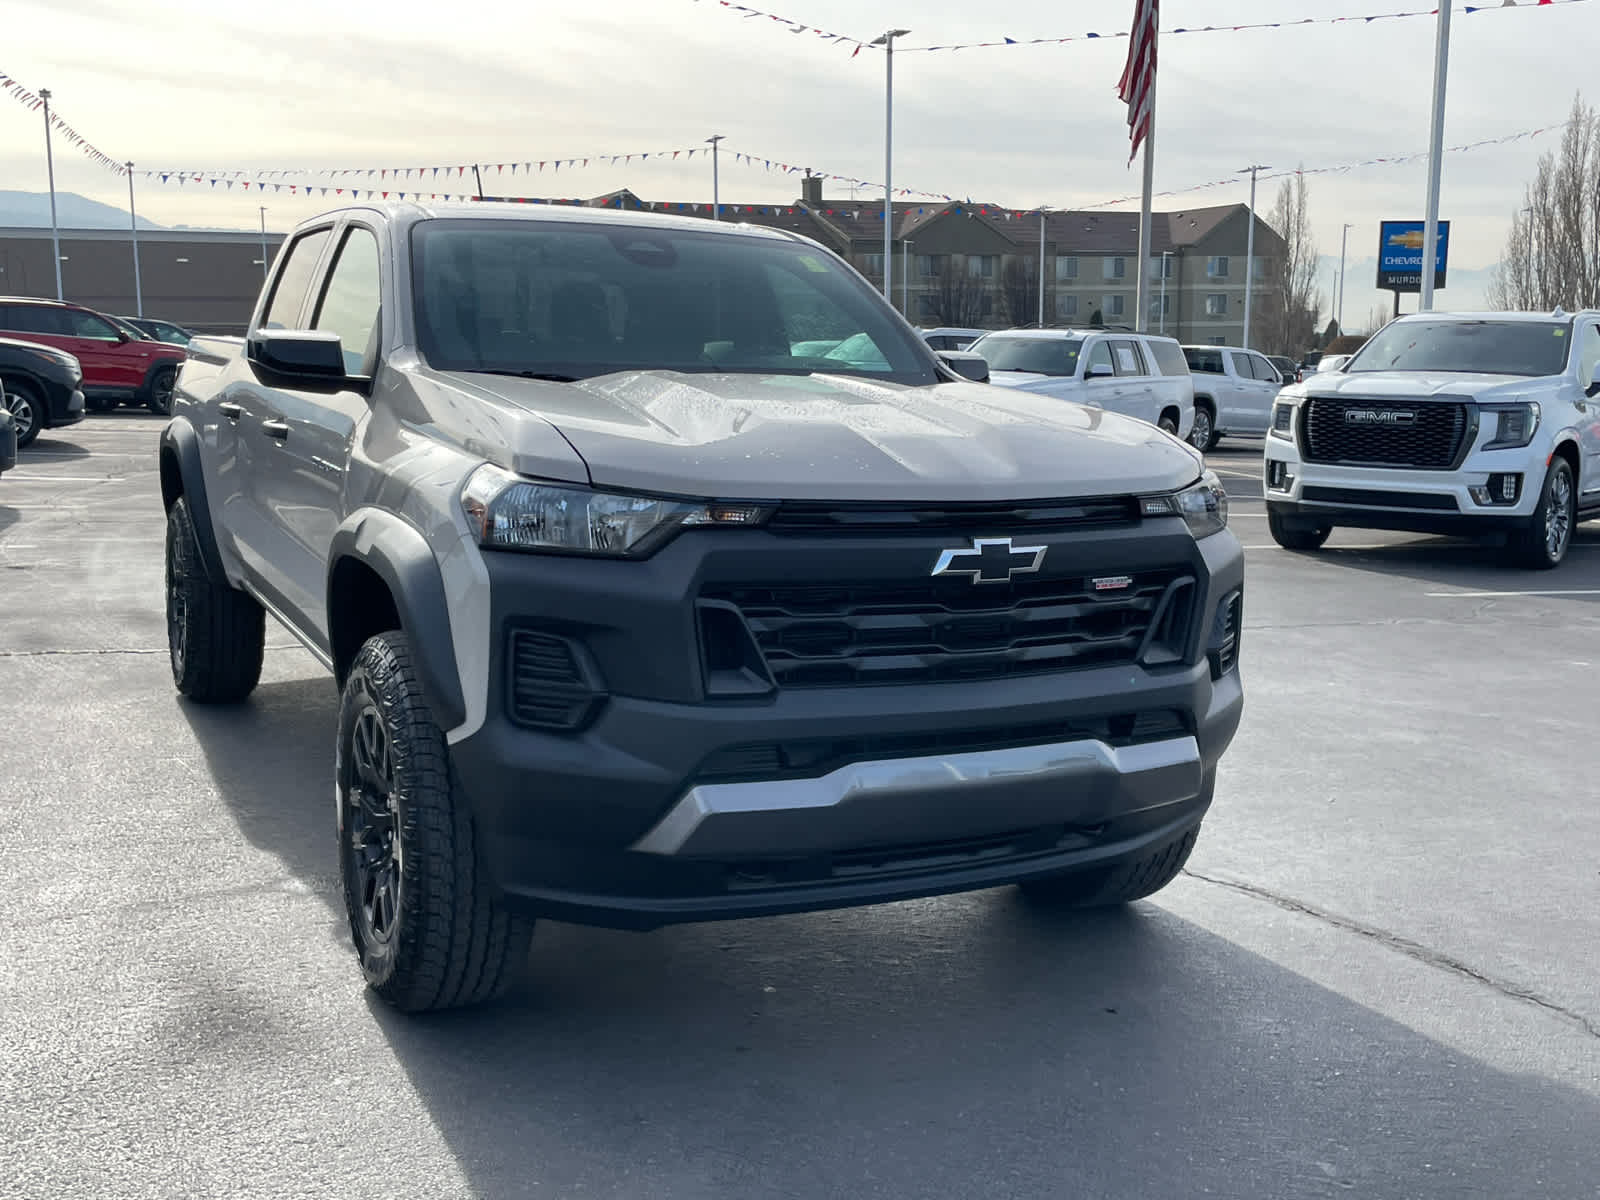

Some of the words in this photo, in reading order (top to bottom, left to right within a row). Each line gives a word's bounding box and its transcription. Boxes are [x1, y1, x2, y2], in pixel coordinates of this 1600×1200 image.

[1384, 256, 1440, 265] CHEVROT
[1388, 275, 1422, 284] MURDO
[1345, 408, 1414, 425] GMC
